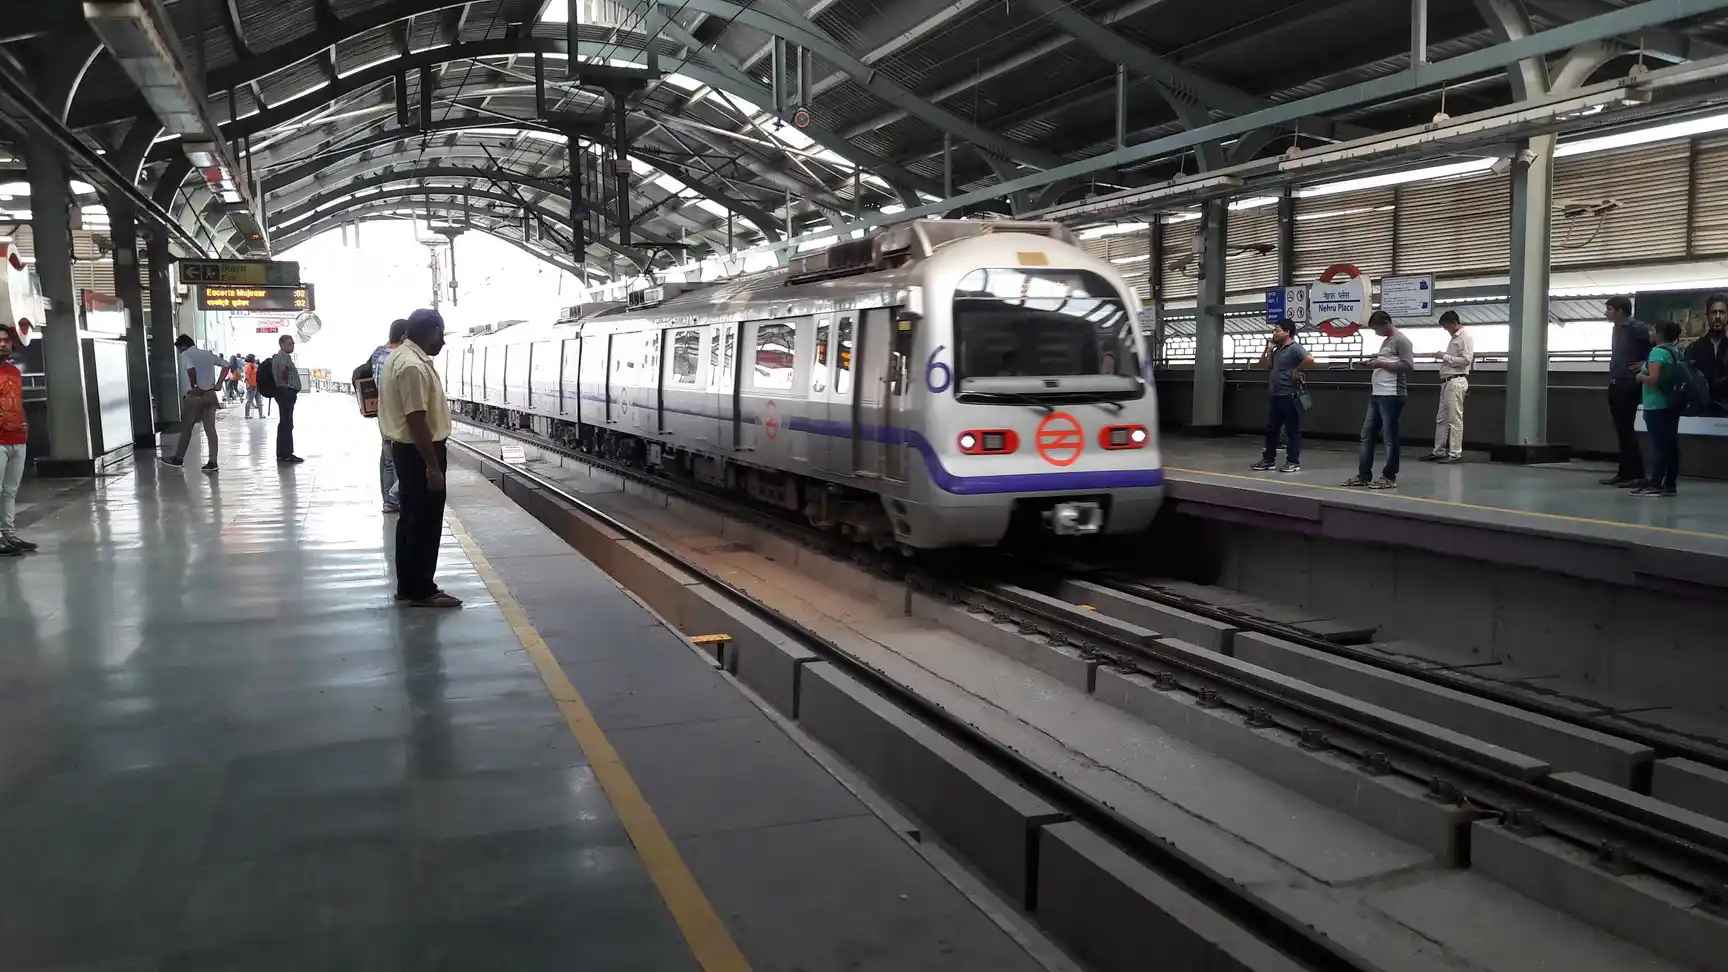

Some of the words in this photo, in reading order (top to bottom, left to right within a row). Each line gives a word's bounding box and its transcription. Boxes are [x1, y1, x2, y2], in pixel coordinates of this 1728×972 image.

[1318, 304, 1336, 313] Nehru
[1338, 303, 1353, 312] Place
[927, 345, 951, 393] 6
